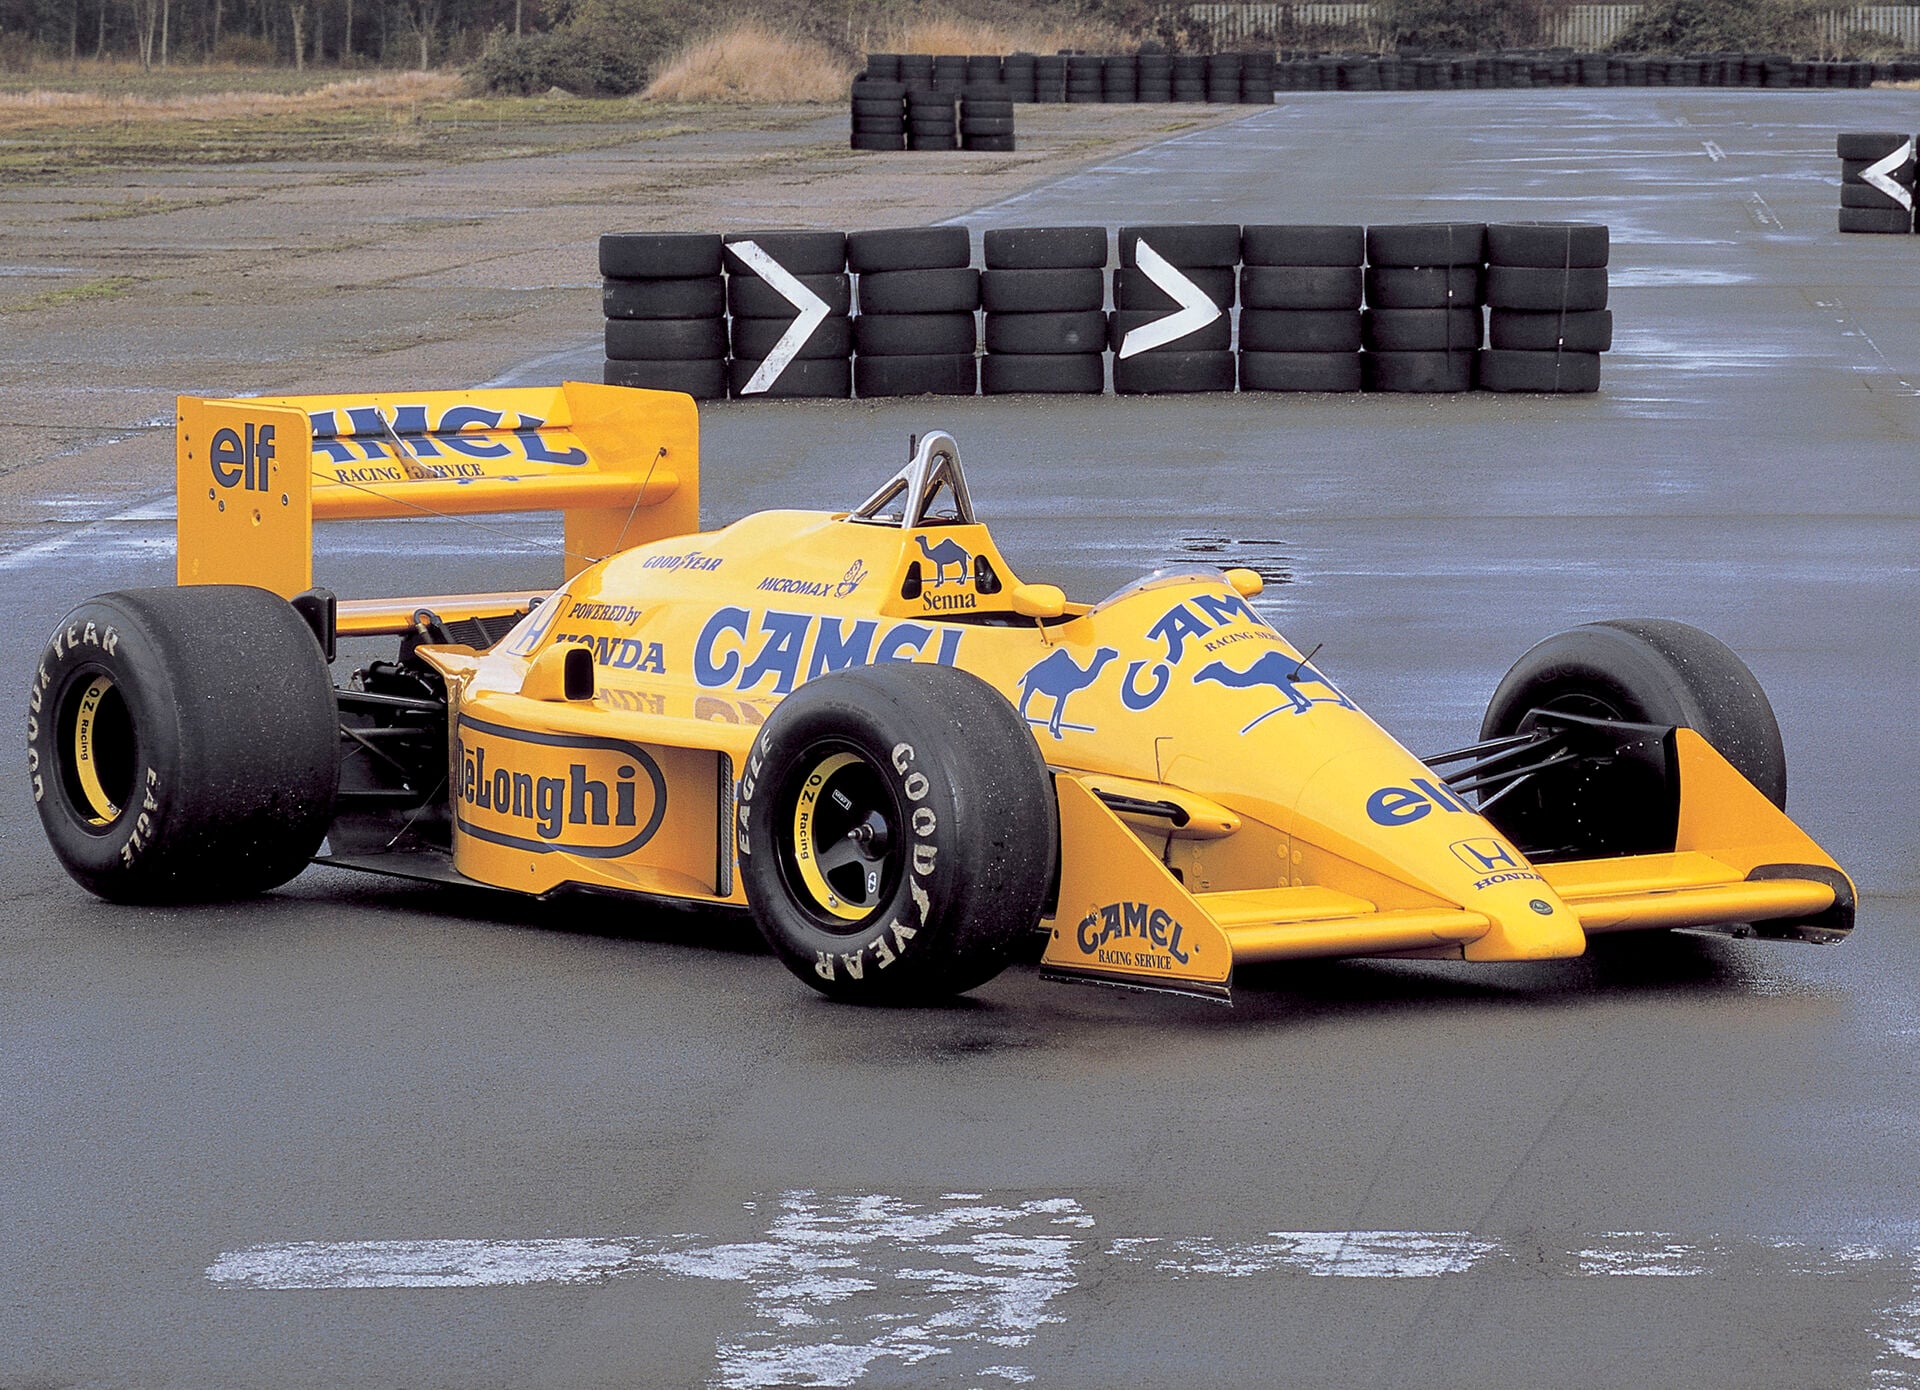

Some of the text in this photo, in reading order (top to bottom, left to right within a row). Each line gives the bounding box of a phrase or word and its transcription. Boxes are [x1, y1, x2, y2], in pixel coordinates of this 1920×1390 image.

[209, 422, 276, 493] elf
[335, 466, 401, 483] RACING
[642, 551, 724, 573] GOODYEAR
[757, 577, 834, 597] MICROMAX
[922, 590, 977, 612] Senna
[568, 602, 642, 626] POWERED by
[1204, 631, 1254, 653] RACING
[80, 719, 90, 762] Racing
[799, 811, 810, 860] Racing
[1077, 902, 1190, 966] CAMEL
[1098, 949, 1173, 970] RACING SERVICE
